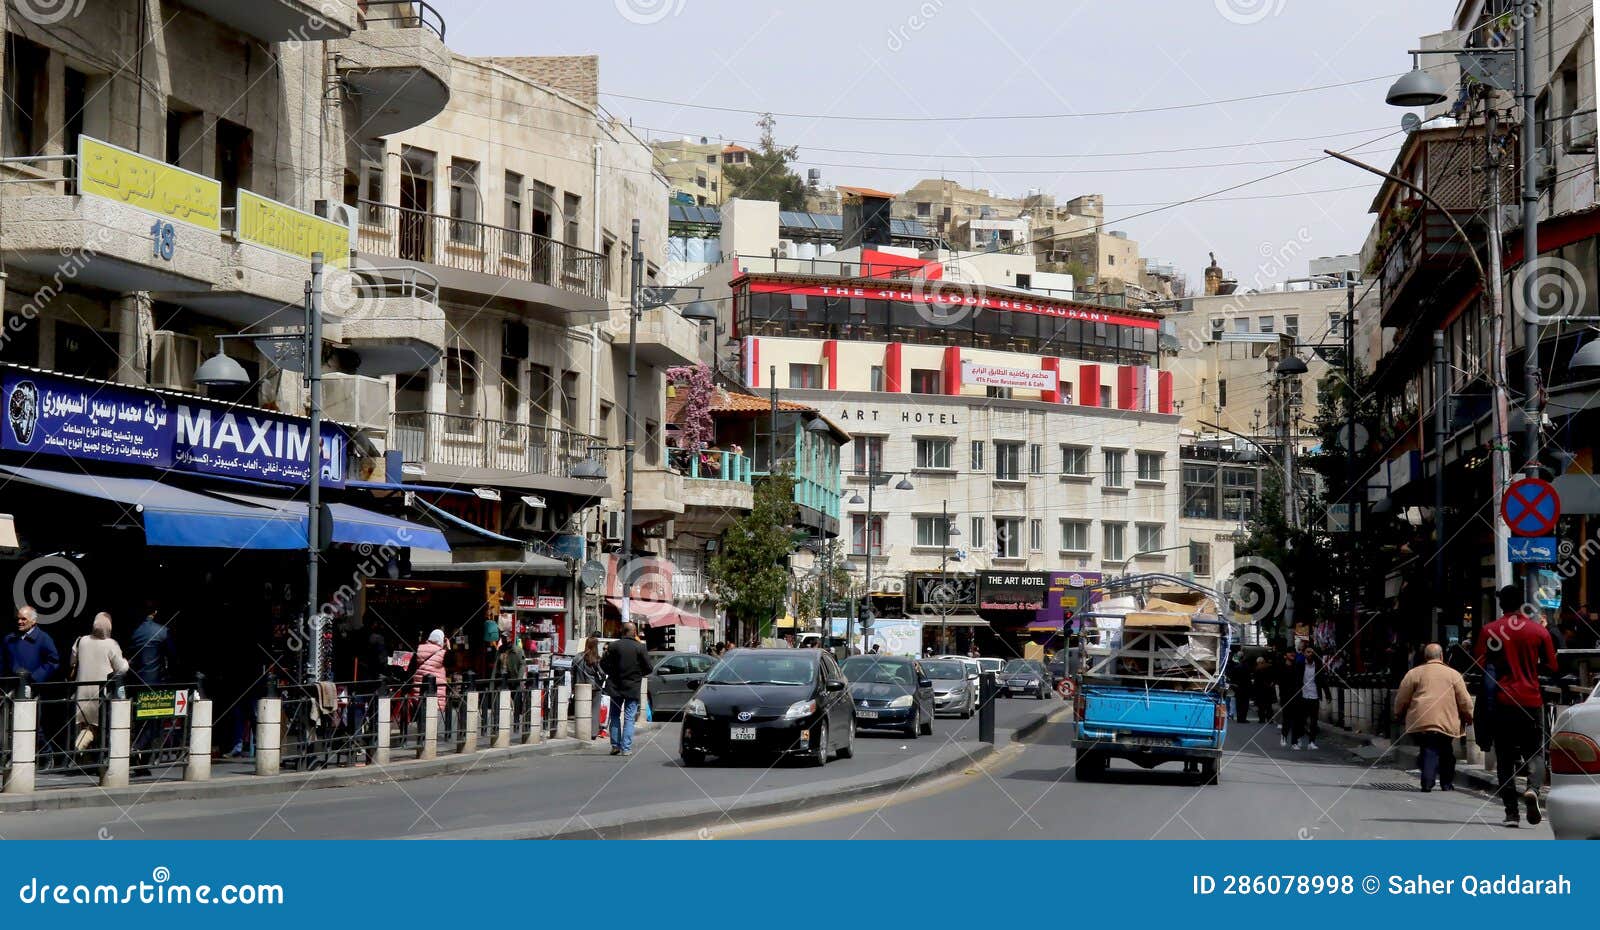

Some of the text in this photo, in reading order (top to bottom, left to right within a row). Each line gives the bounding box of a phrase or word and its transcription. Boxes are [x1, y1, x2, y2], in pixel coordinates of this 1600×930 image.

[150, 219, 175, 261] 18
[820, 286, 1110, 321] THE 4TH FLOOR RESTAURANT
[1000, 378, 1028, 386] Restaurant
[42, 390, 167, 430] شركة محمد وسمير السمهوري
[841, 409, 958, 424] ART HOTEL
[63, 422, 86, 434] الساعات
[101, 427, 113, 439] كافة
[44, 434, 68, 446] الساعات
[113, 431, 134, 443] وتصليح
[134, 435, 144, 444] بيع
[83, 442, 100, 452] لجميع
[101, 443, 115, 455] زجاج
[119, 444, 141, 458] بطاريات
[141, 448, 159, 459] تركيب
[212, 454, 239, 469] كمبيوتر
[987, 576, 1003, 585] THE
[1004, 577, 1020, 585] ART
[1021, 577, 1046, 586] HOTEL
